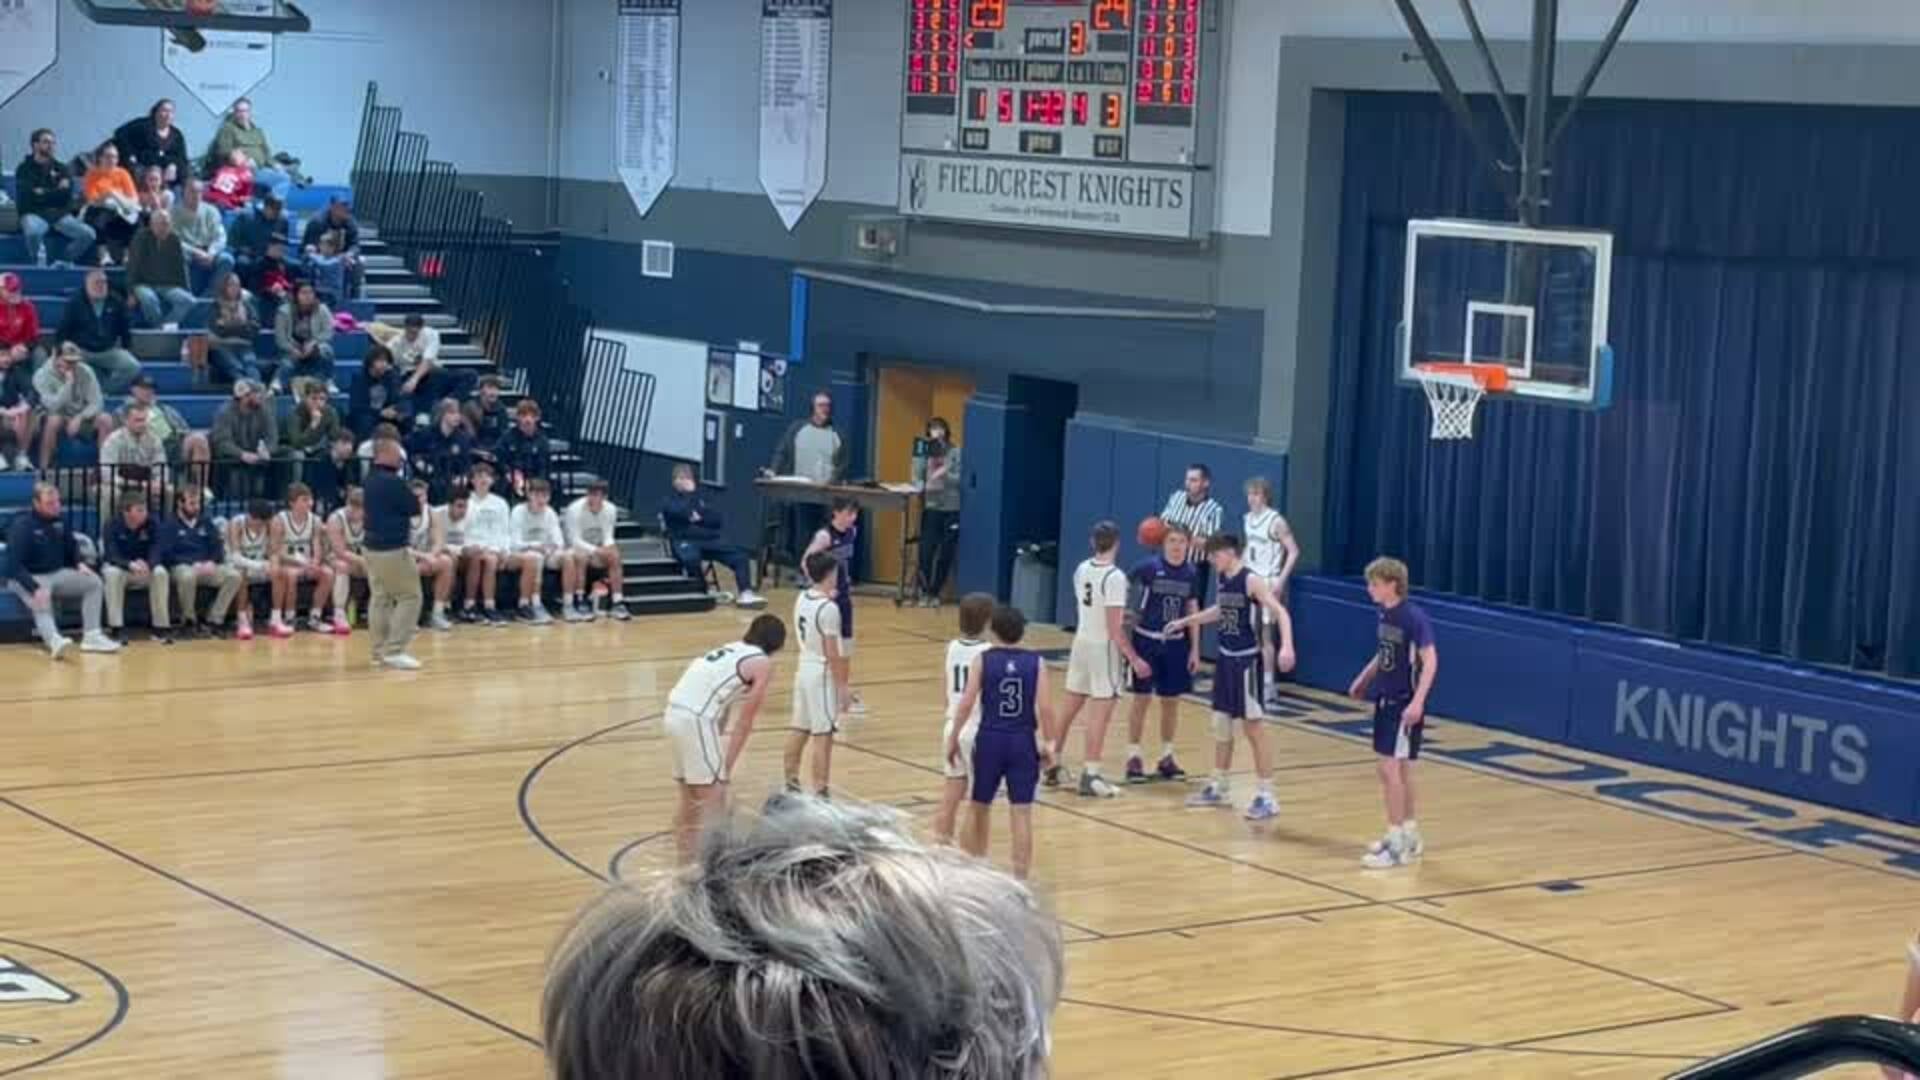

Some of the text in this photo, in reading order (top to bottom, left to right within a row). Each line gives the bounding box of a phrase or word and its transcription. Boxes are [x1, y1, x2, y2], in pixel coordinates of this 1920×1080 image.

[1071, 21, 1085, 54] 3
[998, 90, 1012, 121] 5
[1073, 93, 1087, 124] 4
[1107, 94, 1120, 126] 3
[938, 162, 1184, 210] FIELDCREST KNIGHTS
[1083, 581, 1093, 608] 3
[999, 677, 1022, 717] 3
[1614, 680, 1868, 786] KNIGHTS
